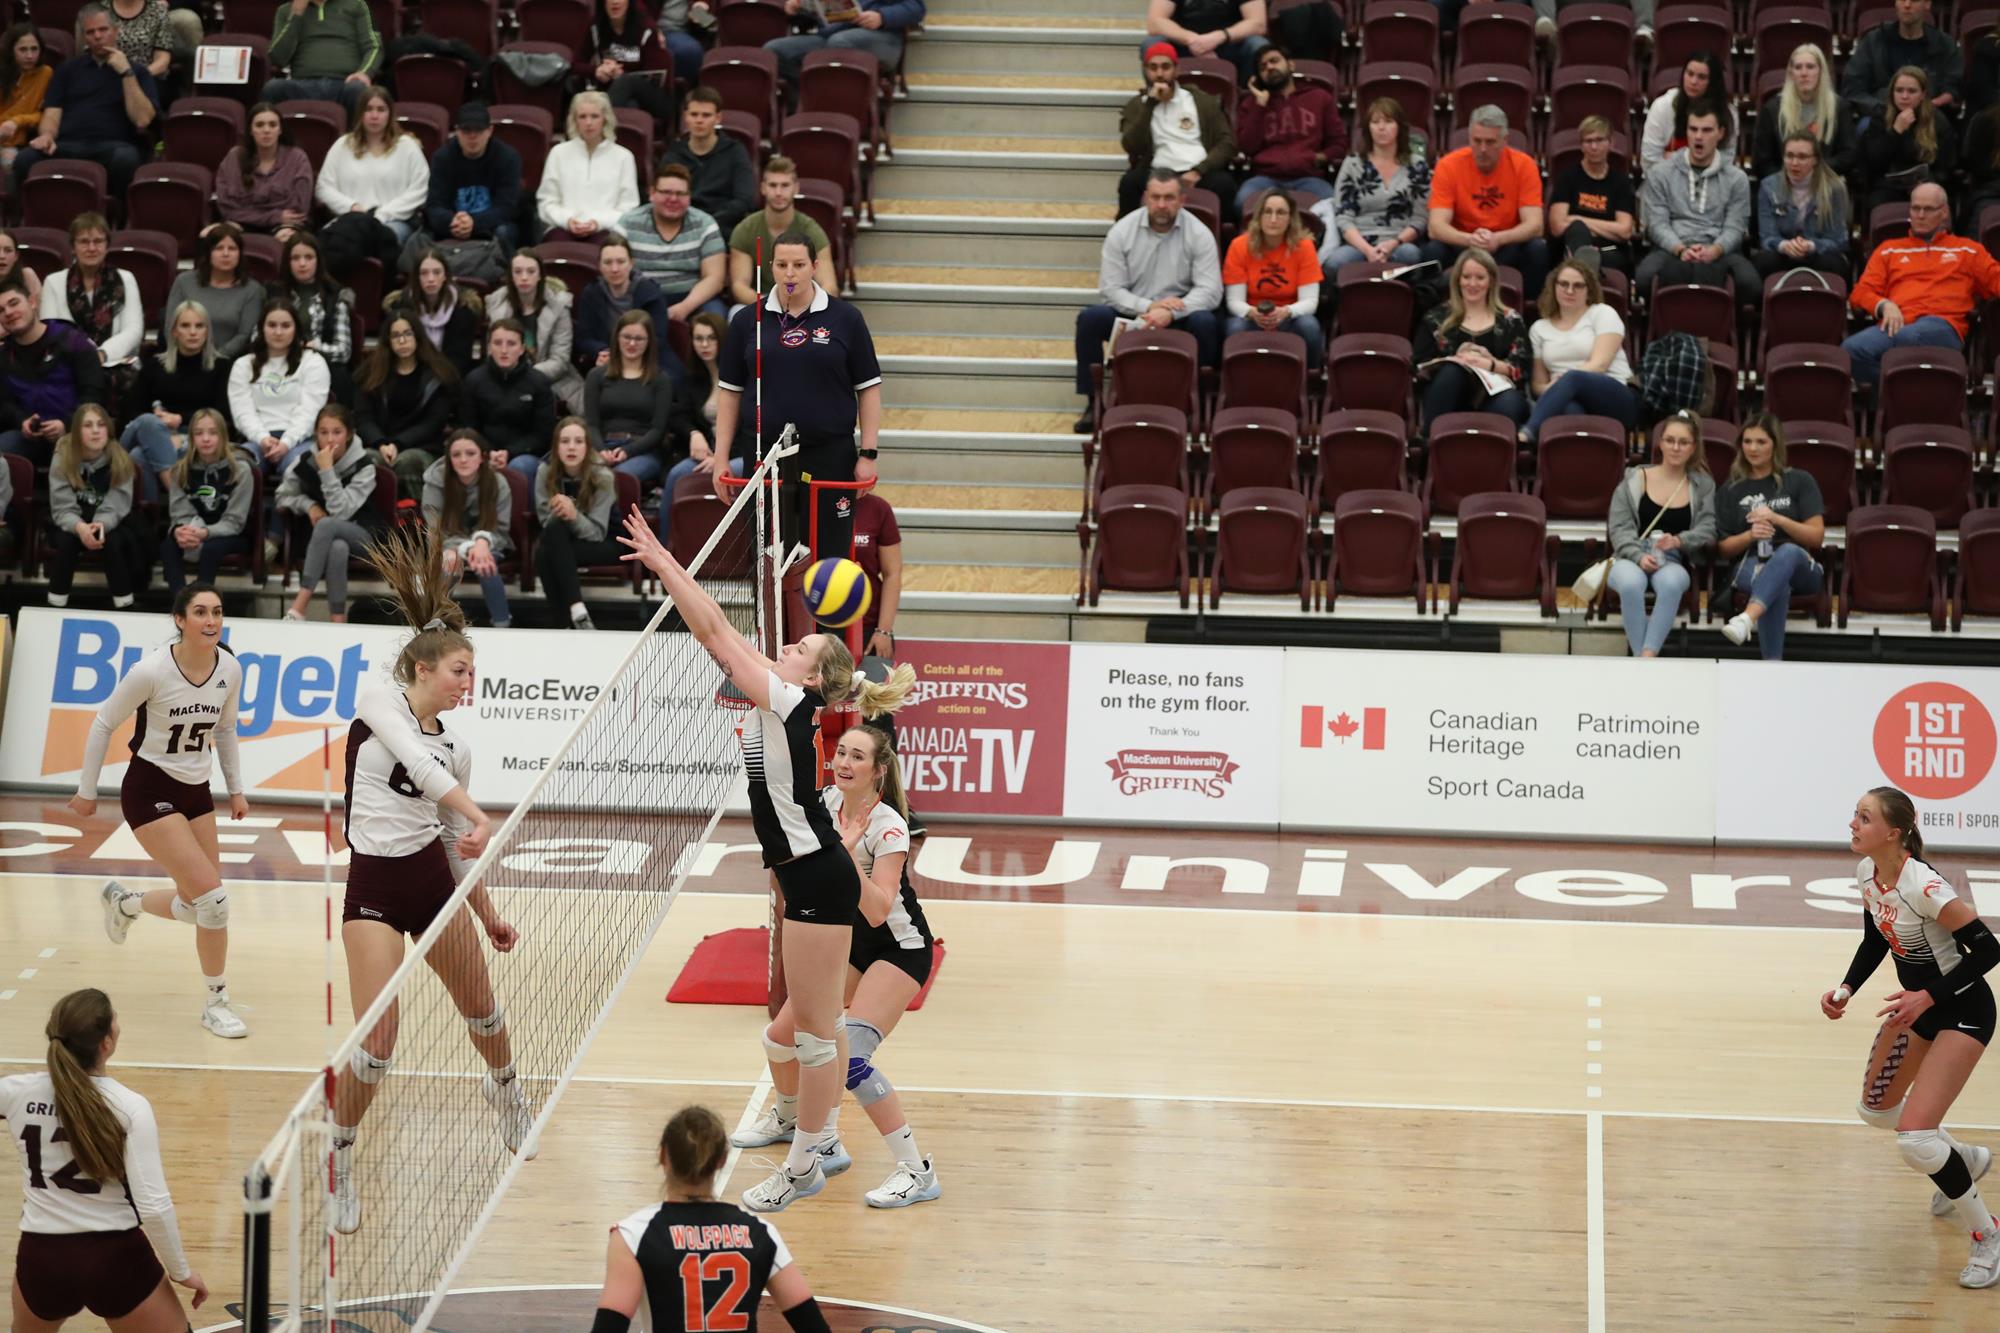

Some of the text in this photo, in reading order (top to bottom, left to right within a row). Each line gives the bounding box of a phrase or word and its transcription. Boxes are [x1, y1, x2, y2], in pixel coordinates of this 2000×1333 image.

[51, 618, 369, 737] Bget
[924, 664, 1004, 676] Catch all of the
[1108, 668, 1244, 688] Please, no fans
[901, 680, 1028, 710] GRIFFINS
[1100, 693, 1250, 713] on the gym floor.
[480, 706, 586, 722] UNIVERSIT
[937, 703, 986, 715] action on
[1429, 709, 1538, 731] Canadian
[1149, 726, 1200, 737] Thank You
[1577, 713, 1700, 735] Patrimoine
[1904, 701, 1966, 744] 1ST
[165, 722, 216, 754] 15
[895, 726, 968, 753] ANADA
[1429, 734, 1525, 760] Heritage
[1123, 753, 1223, 768] MacEwan University
[1576, 741, 1682, 760] canadien
[1904, 747, 1966, 778] RND
[1119, 775, 1225, 799] GRIFFINS
[1427, 776, 1585, 800] Sport Canada
[1923, 812, 1954, 827] BEER
[26, 1101, 58, 1117] GRI
[669, 1224, 754, 1251] WOLFPACK
[679, 1251, 751, 1333] 12
